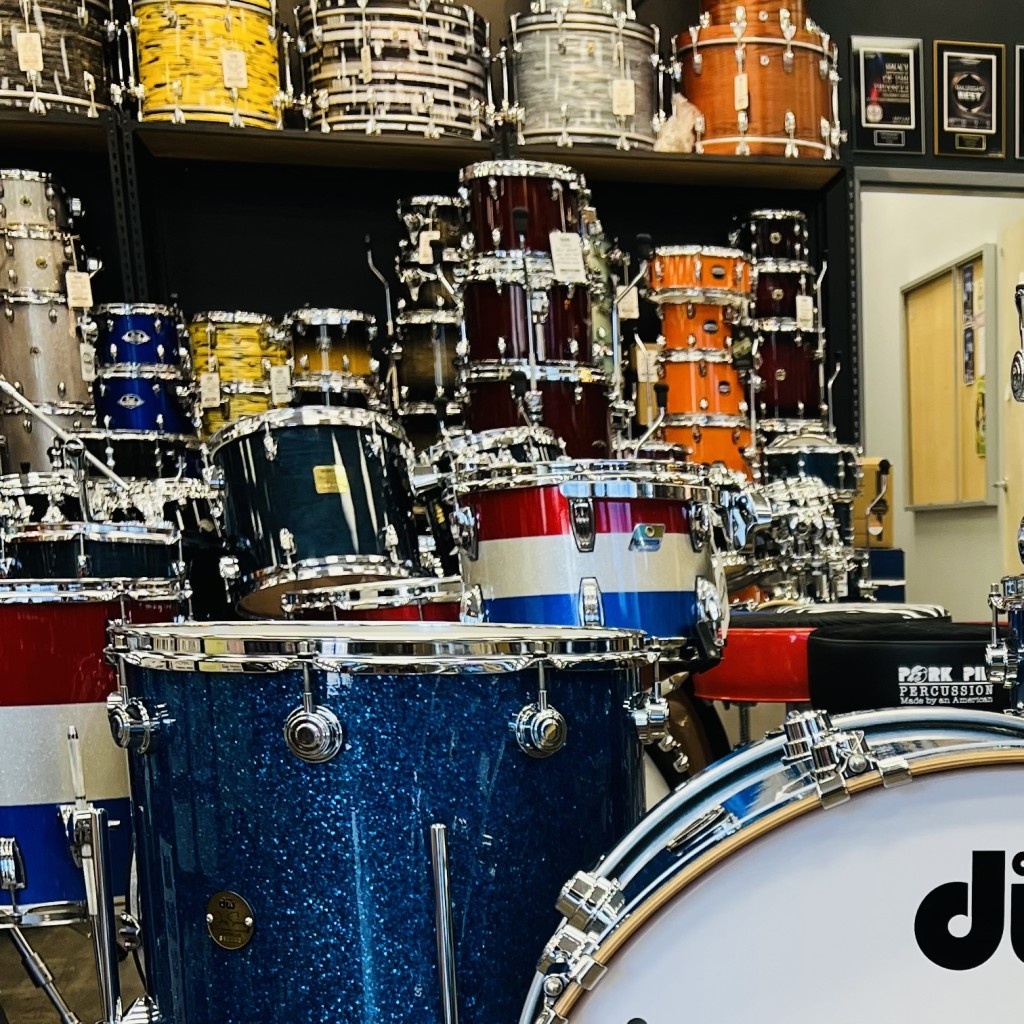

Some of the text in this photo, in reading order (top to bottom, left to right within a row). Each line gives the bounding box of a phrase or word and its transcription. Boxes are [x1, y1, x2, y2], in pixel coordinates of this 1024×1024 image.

[900, 685, 994, 697] PERCUSSION
[900, 697, 924, 705] Made
[926, 697, 937, 705] by
